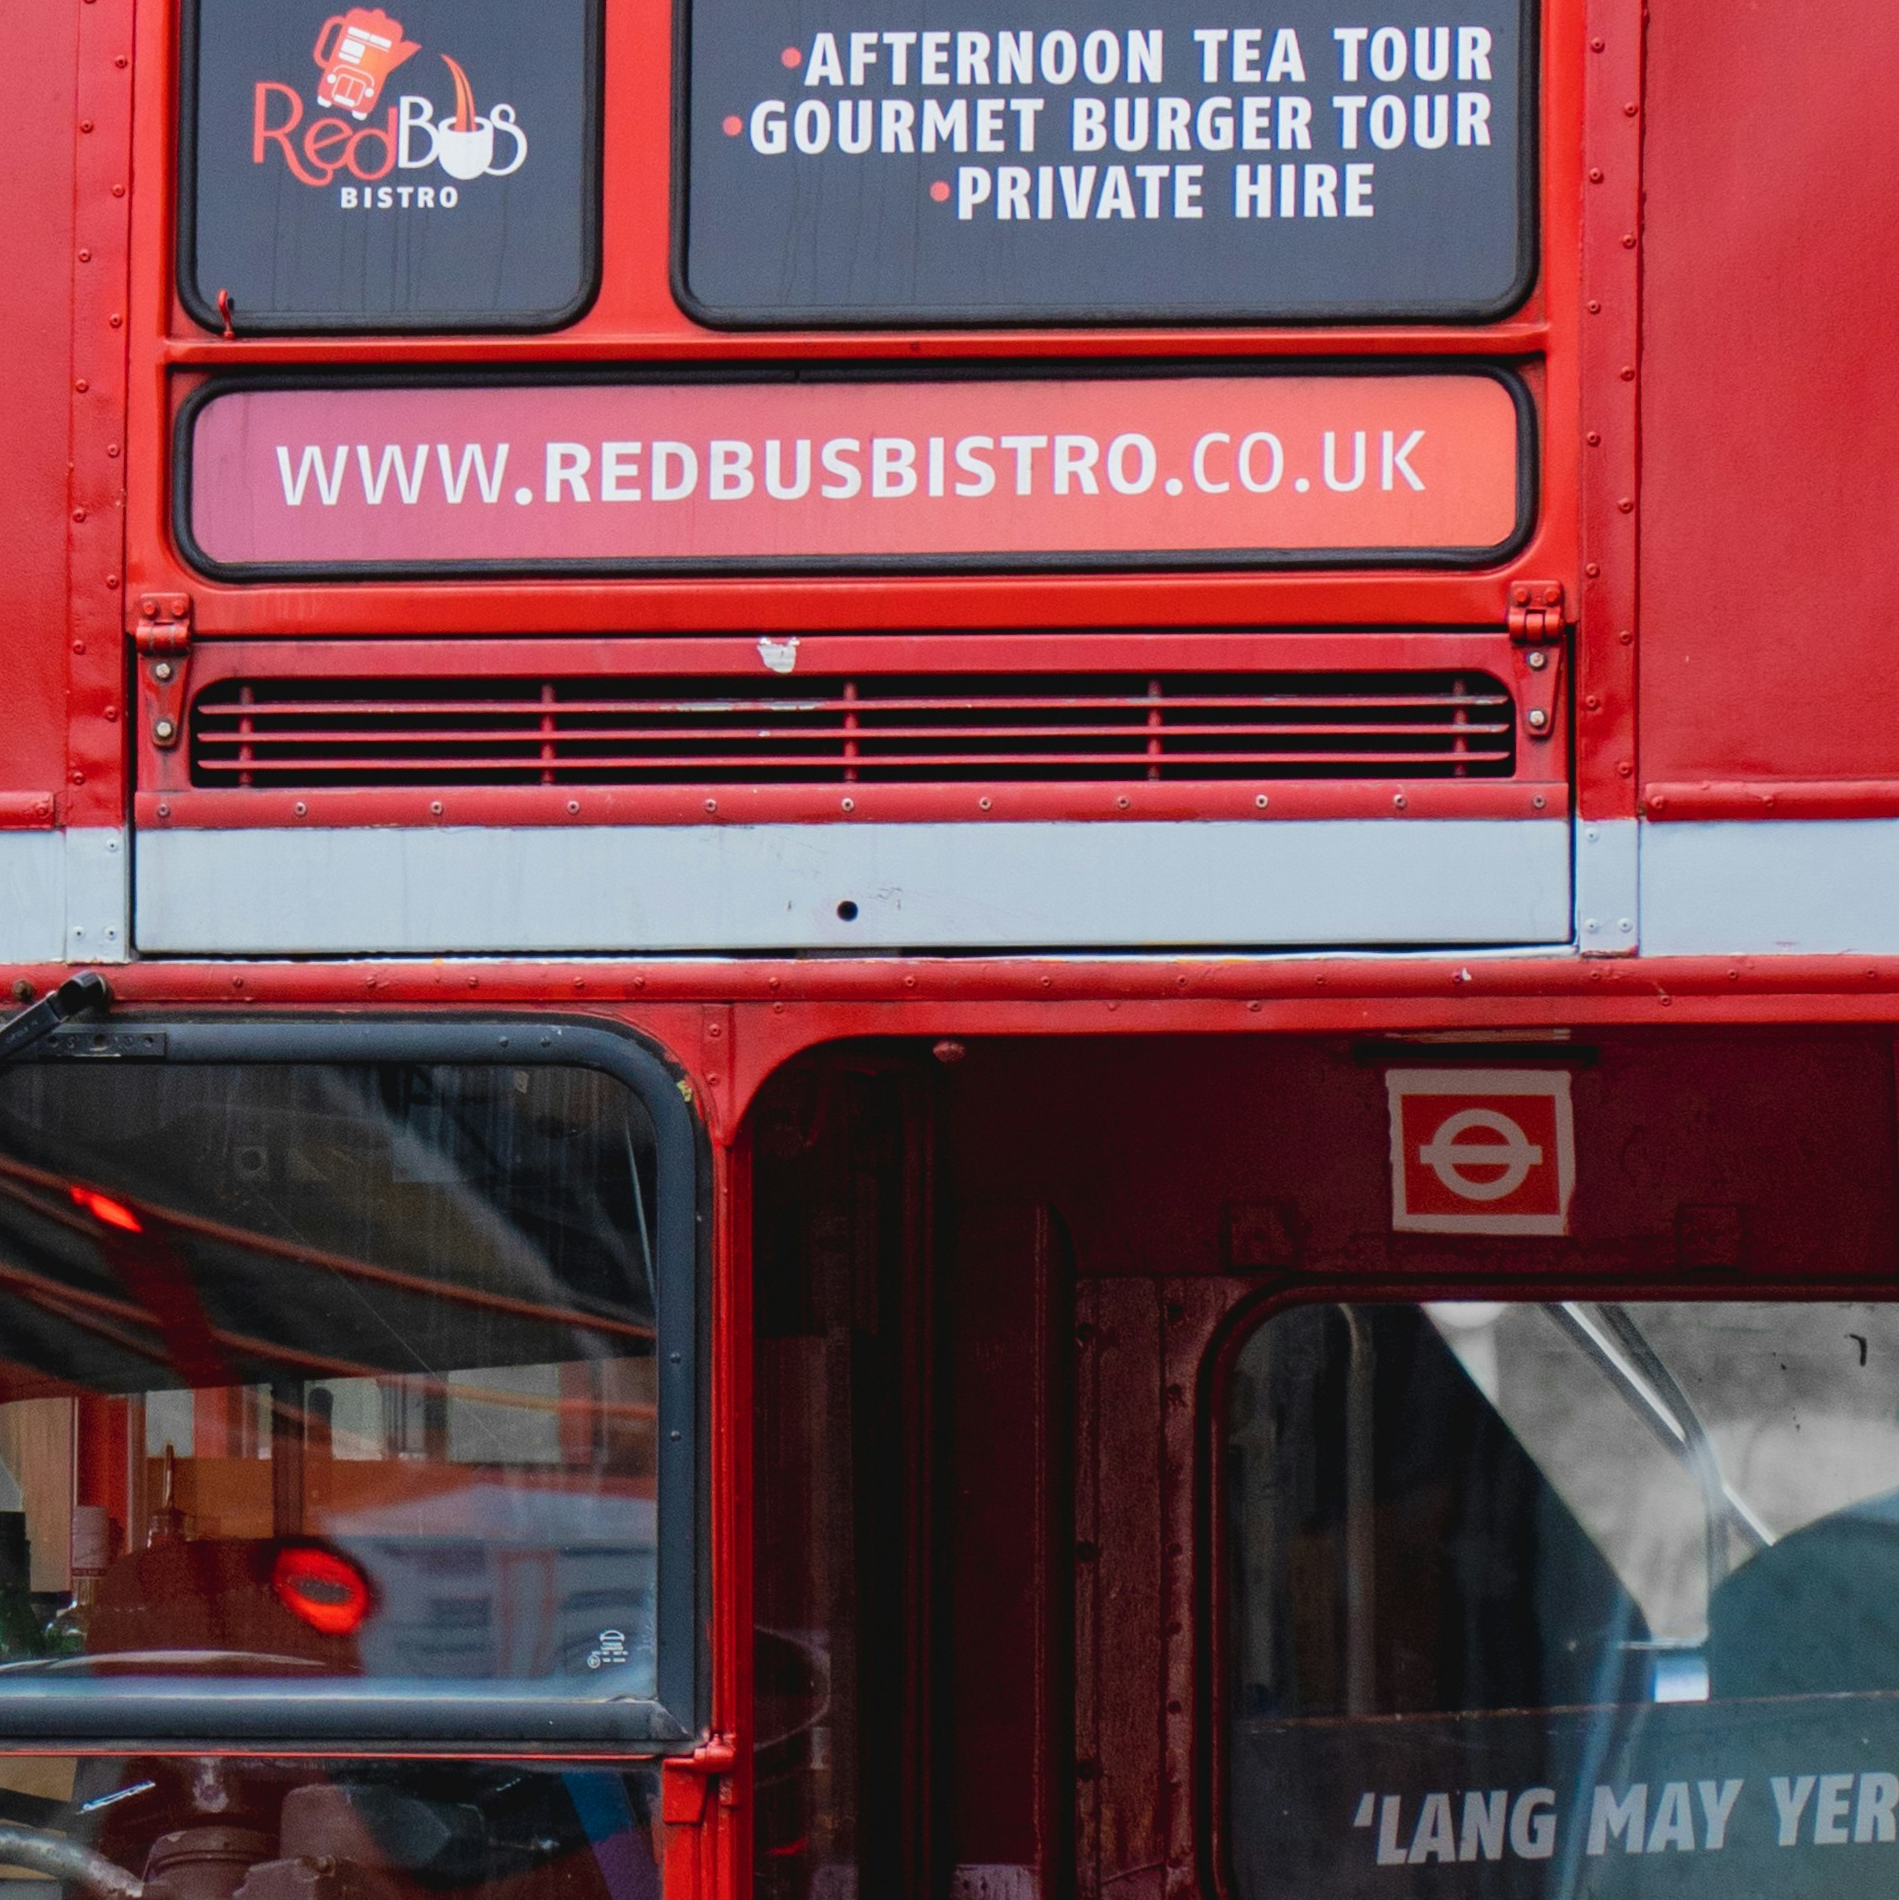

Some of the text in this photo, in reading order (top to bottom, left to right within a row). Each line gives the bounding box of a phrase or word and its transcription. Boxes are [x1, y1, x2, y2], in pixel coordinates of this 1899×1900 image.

[803, 26, 1493, 86] AFTERNOON TEA TOUR
[749, 92, 1492, 155] GOURMET BURGER TOUR
[340, 185, 459, 209] BISTRO
[957, 163, 1375, 220] PRIVATE HIRE
[275, 429, 1427, 506] WWW.REDBUSBISTRO.CO.UK
[1586, 1779, 1744, 1856] MAY
[1769, 1771, 1899, 1847] YER
